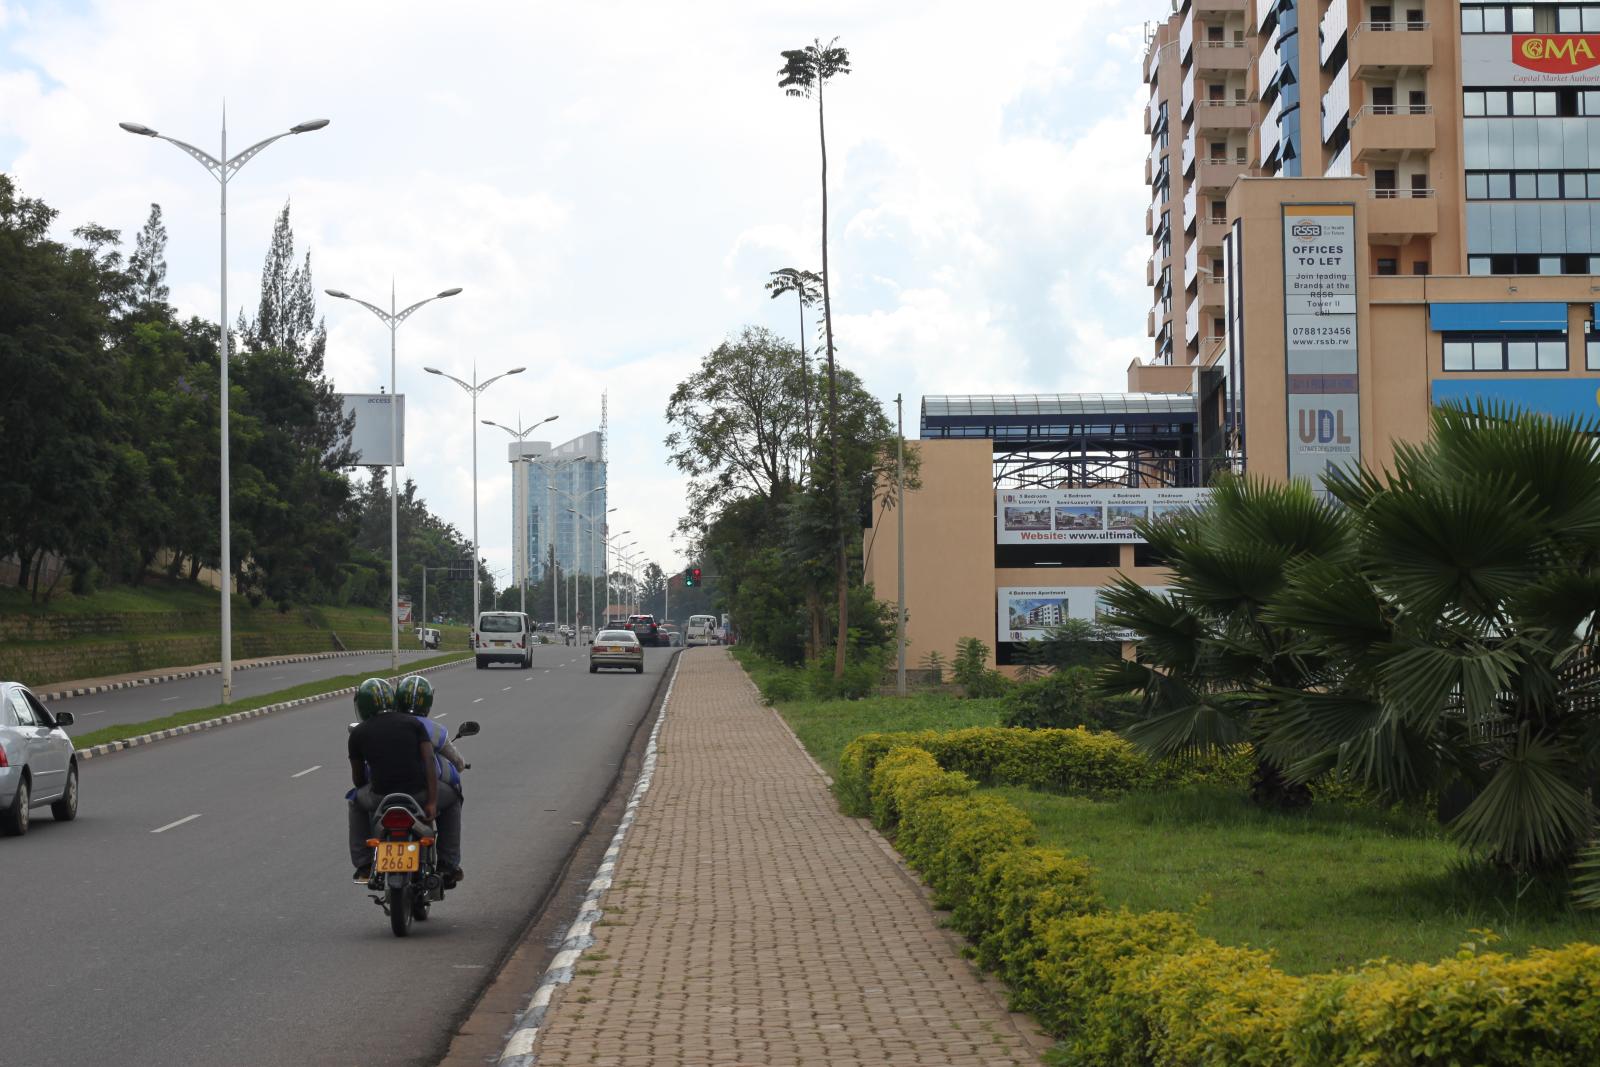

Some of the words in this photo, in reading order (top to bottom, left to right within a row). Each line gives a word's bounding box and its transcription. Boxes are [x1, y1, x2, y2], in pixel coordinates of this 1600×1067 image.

[1521, 38, 1596, 65] CMA
[1513, 74, 1539, 83] Capital
[1292, 225, 1321, 236] RSSB
[1292, 246, 1344, 254] OFFICES
[1298, 257, 1315, 266] TO
[1319, 257, 1342, 266] LET
[1316, 273, 1347, 281] leading
[1307, 300, 1332, 308] Tower
[1292, 328, 1351, 336] 0788123456
[1298, 409, 1351, 444] UDL
[1020, 532, 1067, 540] Website:
